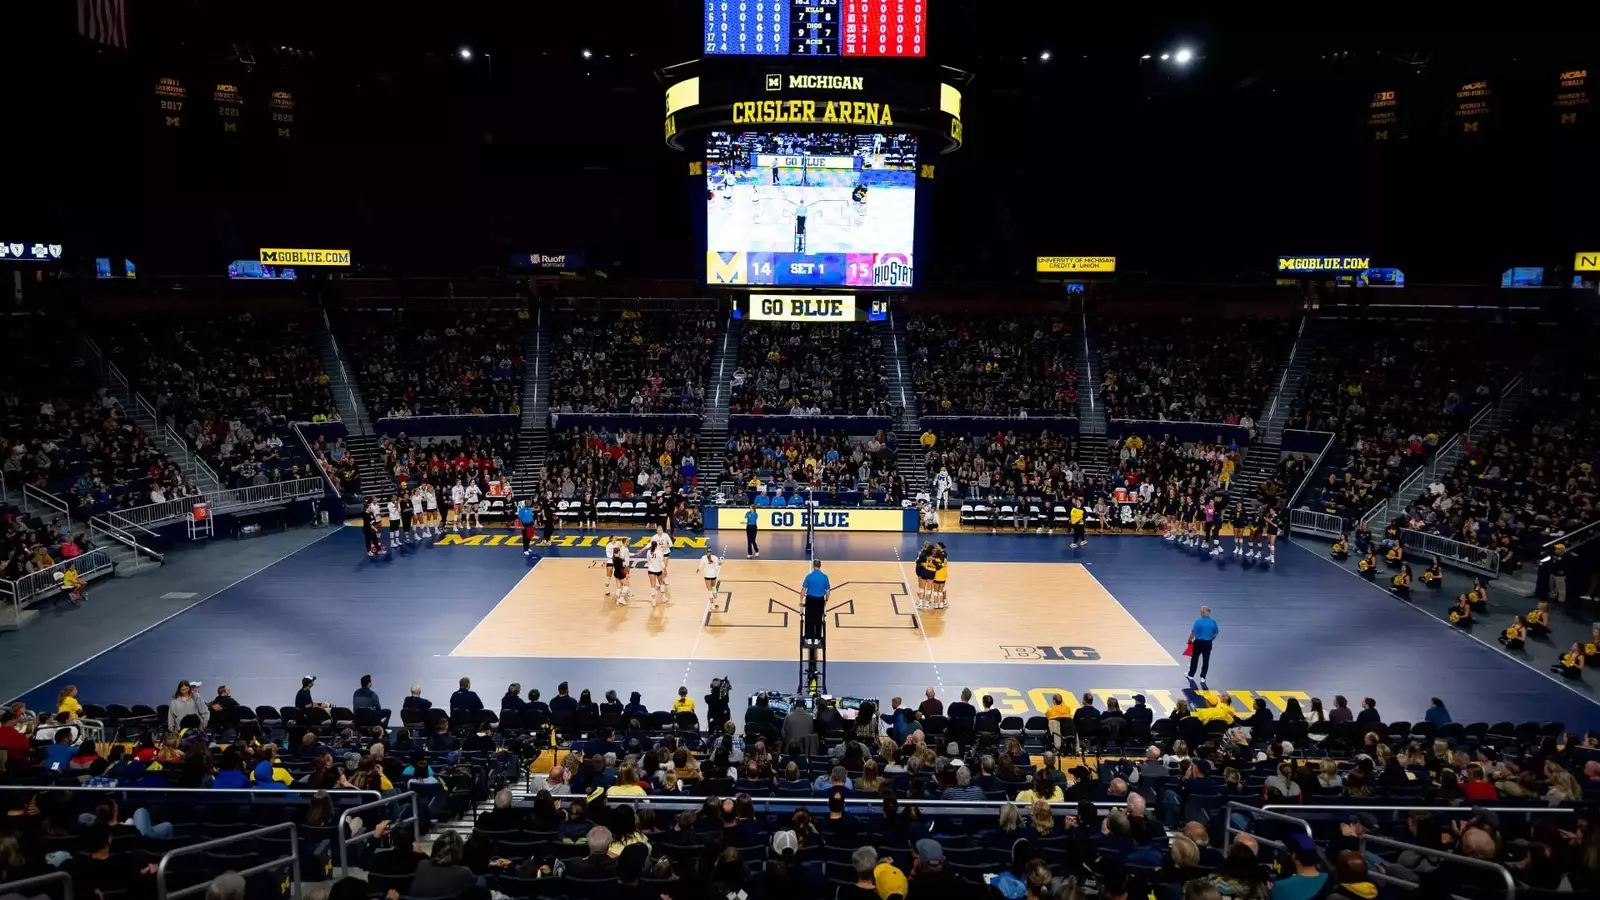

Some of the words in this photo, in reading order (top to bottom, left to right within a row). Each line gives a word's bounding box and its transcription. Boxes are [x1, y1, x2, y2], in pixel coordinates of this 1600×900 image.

[721, 3, 727, 11] 0
[740, 3, 746, 11] 0
[757, 3, 763, 11] 0
[774, 3, 780, 11] 0
[862, 4, 868, 12] 0
[881, 4, 886, 12] 0
[721, 13, 727, 21] 1
[740, 13, 746, 21] 0
[757, 13, 763, 21] 0
[774, 13, 780, 22] 0
[799, 13, 805, 21] 7
[825, 13, 831, 21] 8
[915, 15, 920, 23] 0
[721, 23, 727, 31] 0
[740, 23, 745, 31] 1
[757, 23, 763, 31] 6
[774, 23, 780, 32] 0
[880, 25, 886, 33] 0
[898, 25, 903, 33] 0
[915, 25, 920, 33] 1
[721, 33, 727, 41] 1
[740, 33, 745, 41] 0
[757, 33, 763, 42] 0
[774, 34, 780, 42] 0
[798, 29, 804, 37] 9
[825, 29, 831, 37] 7
[847, 34, 855, 42] 22
[880, 35, 886, 43] 0
[897, 35, 903, 43] 0
[915, 35, 920, 43] 0
[707, 43, 715, 51] 27
[721, 43, 727, 51] 4
[740, 43, 745, 51] 1
[756, 44, 762, 52] 0
[774, 44, 779, 52] 1
[825, 45, 831, 53] 1
[880, 45, 885, 53] 0
[897, 45, 902, 53] 0
[914, 45, 920, 53] 0
[789, 75, 864, 90] MICHIGAN
[161, 100, 183, 111] 2017
[219, 107, 239, 117] 2021
[732, 100, 816, 123] CRISLER
[823, 101, 893, 125] ARENA
[165, 116, 180, 127] M
[1463, 121, 1479, 132] M
[223, 122, 237, 132] M
[1375, 130, 1388, 140] M
[785, 157, 797, 165] GO
[688, 160, 703, 176] M
[920, 163, 935, 179] M
[262, 251, 349, 263] MGOBLUE.COM
[541, 255, 565, 263] Ruoff
[1279, 257, 1370, 270] MGOBLUE.COM
[752, 262, 771, 276] 14
[790, 263, 815, 274] SET
[818, 263, 825, 275] 1
[851, 263, 869, 277] 15
[761, 299, 783, 316] GO
[790, 299, 843, 316] BLUE
[771, 511, 794, 527] GO
[973, 687, 1083, 719] GO
